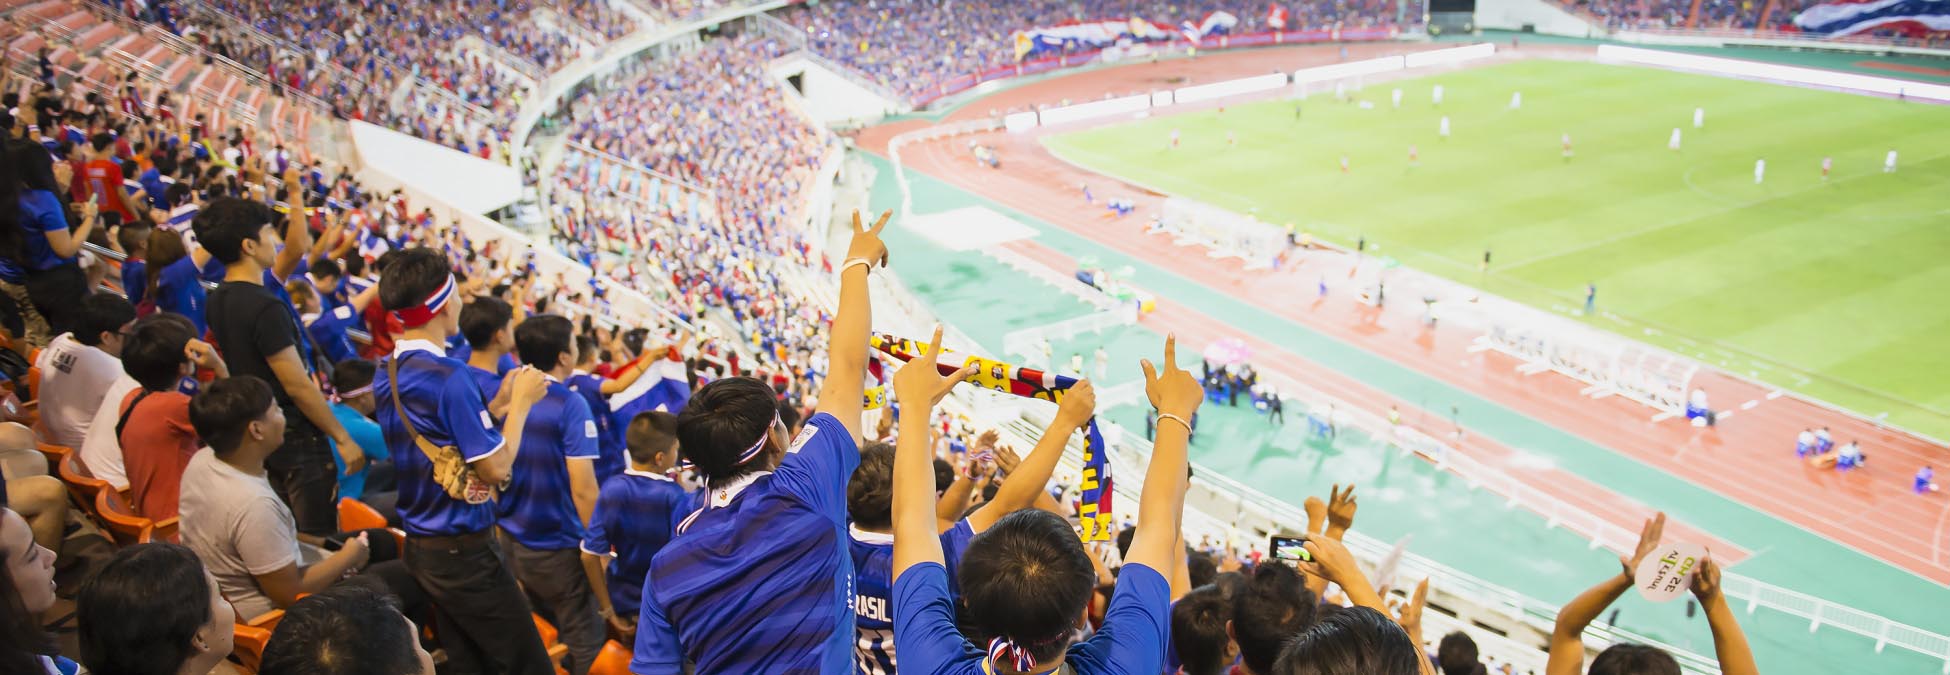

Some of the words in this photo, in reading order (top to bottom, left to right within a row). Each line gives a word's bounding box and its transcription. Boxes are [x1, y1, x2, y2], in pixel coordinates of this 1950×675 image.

[1664, 577, 1682, 593] 32
[1677, 556, 1696, 577] HD
[856, 594, 892, 622] RASIL
